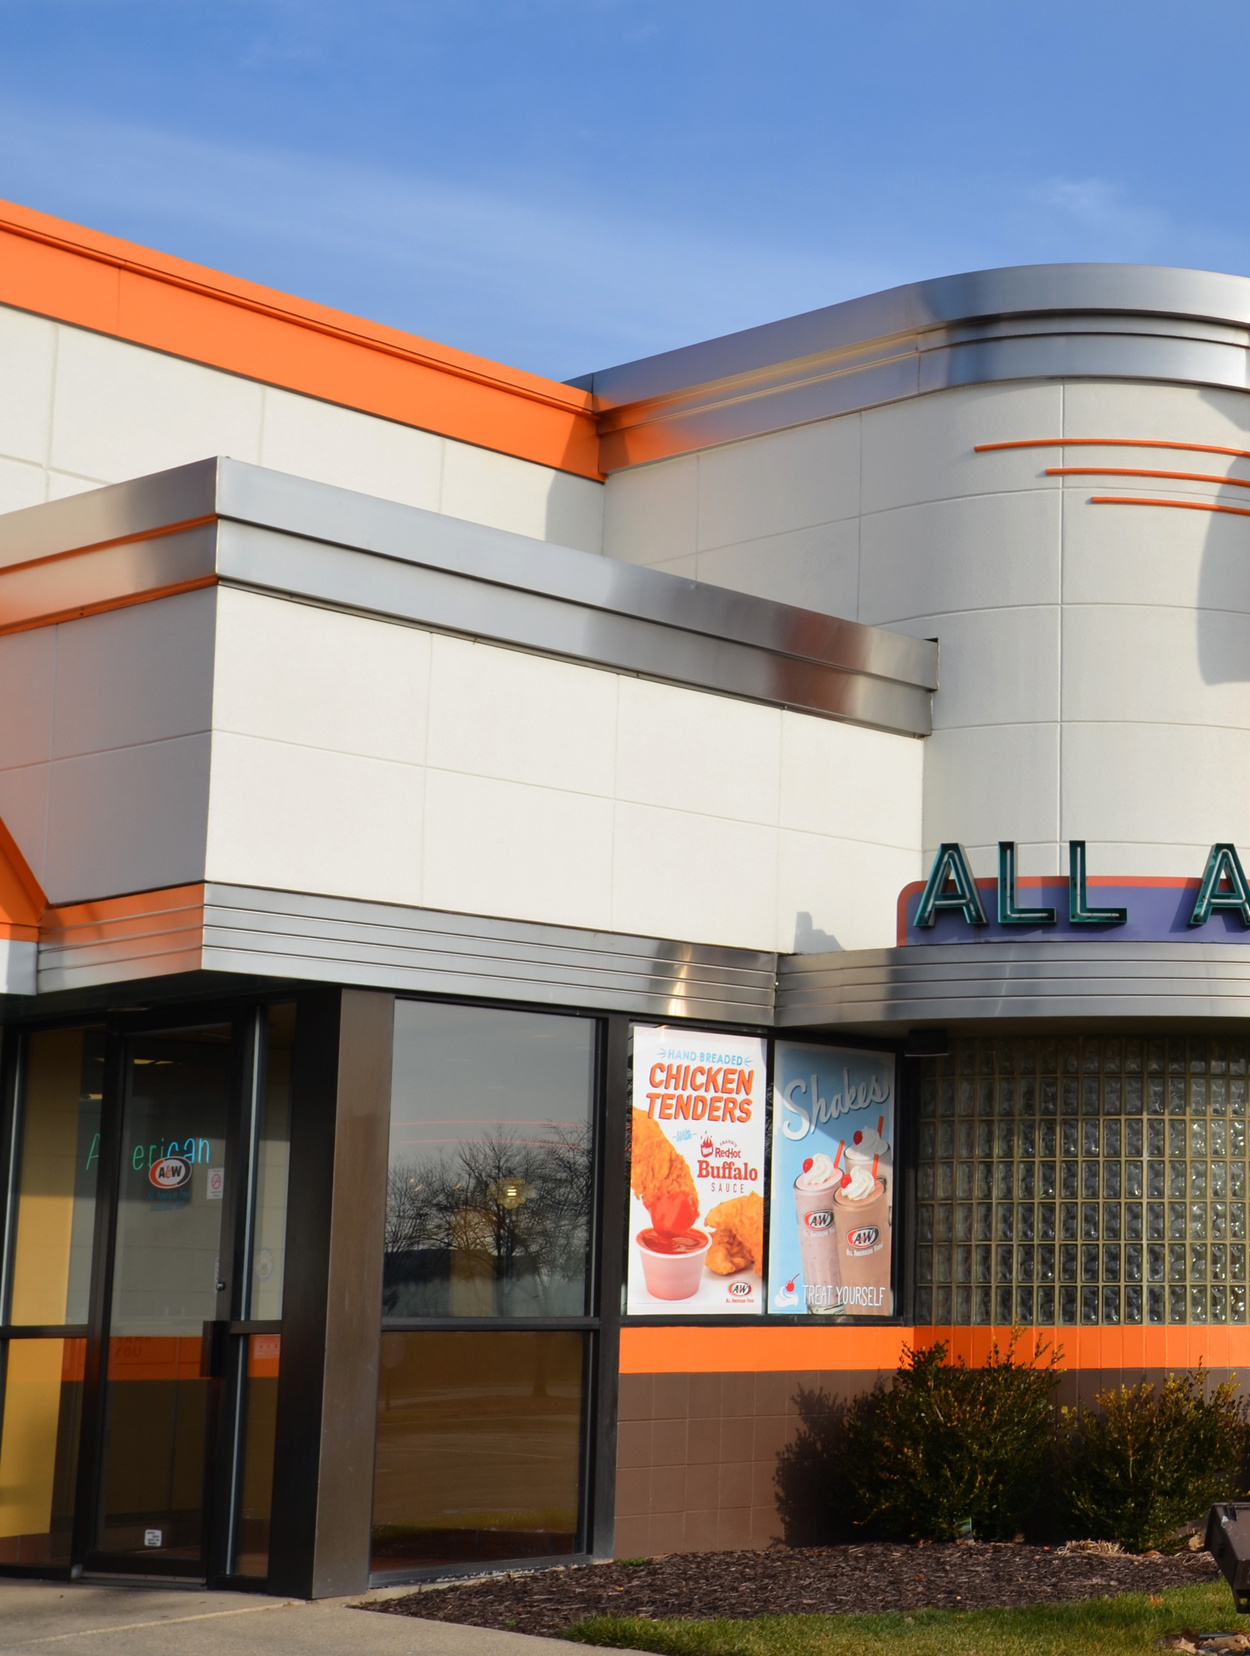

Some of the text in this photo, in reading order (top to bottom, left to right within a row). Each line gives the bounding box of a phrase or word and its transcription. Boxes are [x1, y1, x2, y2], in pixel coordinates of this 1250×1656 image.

[913, 840, 1127, 927] ALL
[668, 1049, 743, 1066] HAND BREADED
[649, 1062, 754, 1096] CHICKEN
[646, 1092, 753, 1123] TENDERS
[783, 1067, 890, 1141] Shakes
[697, 1159, 758, 1181] Buffalo
[711, 1182, 744, 1194] SAUCE
[803, 1285, 886, 1306] TREAT YOURSELF
